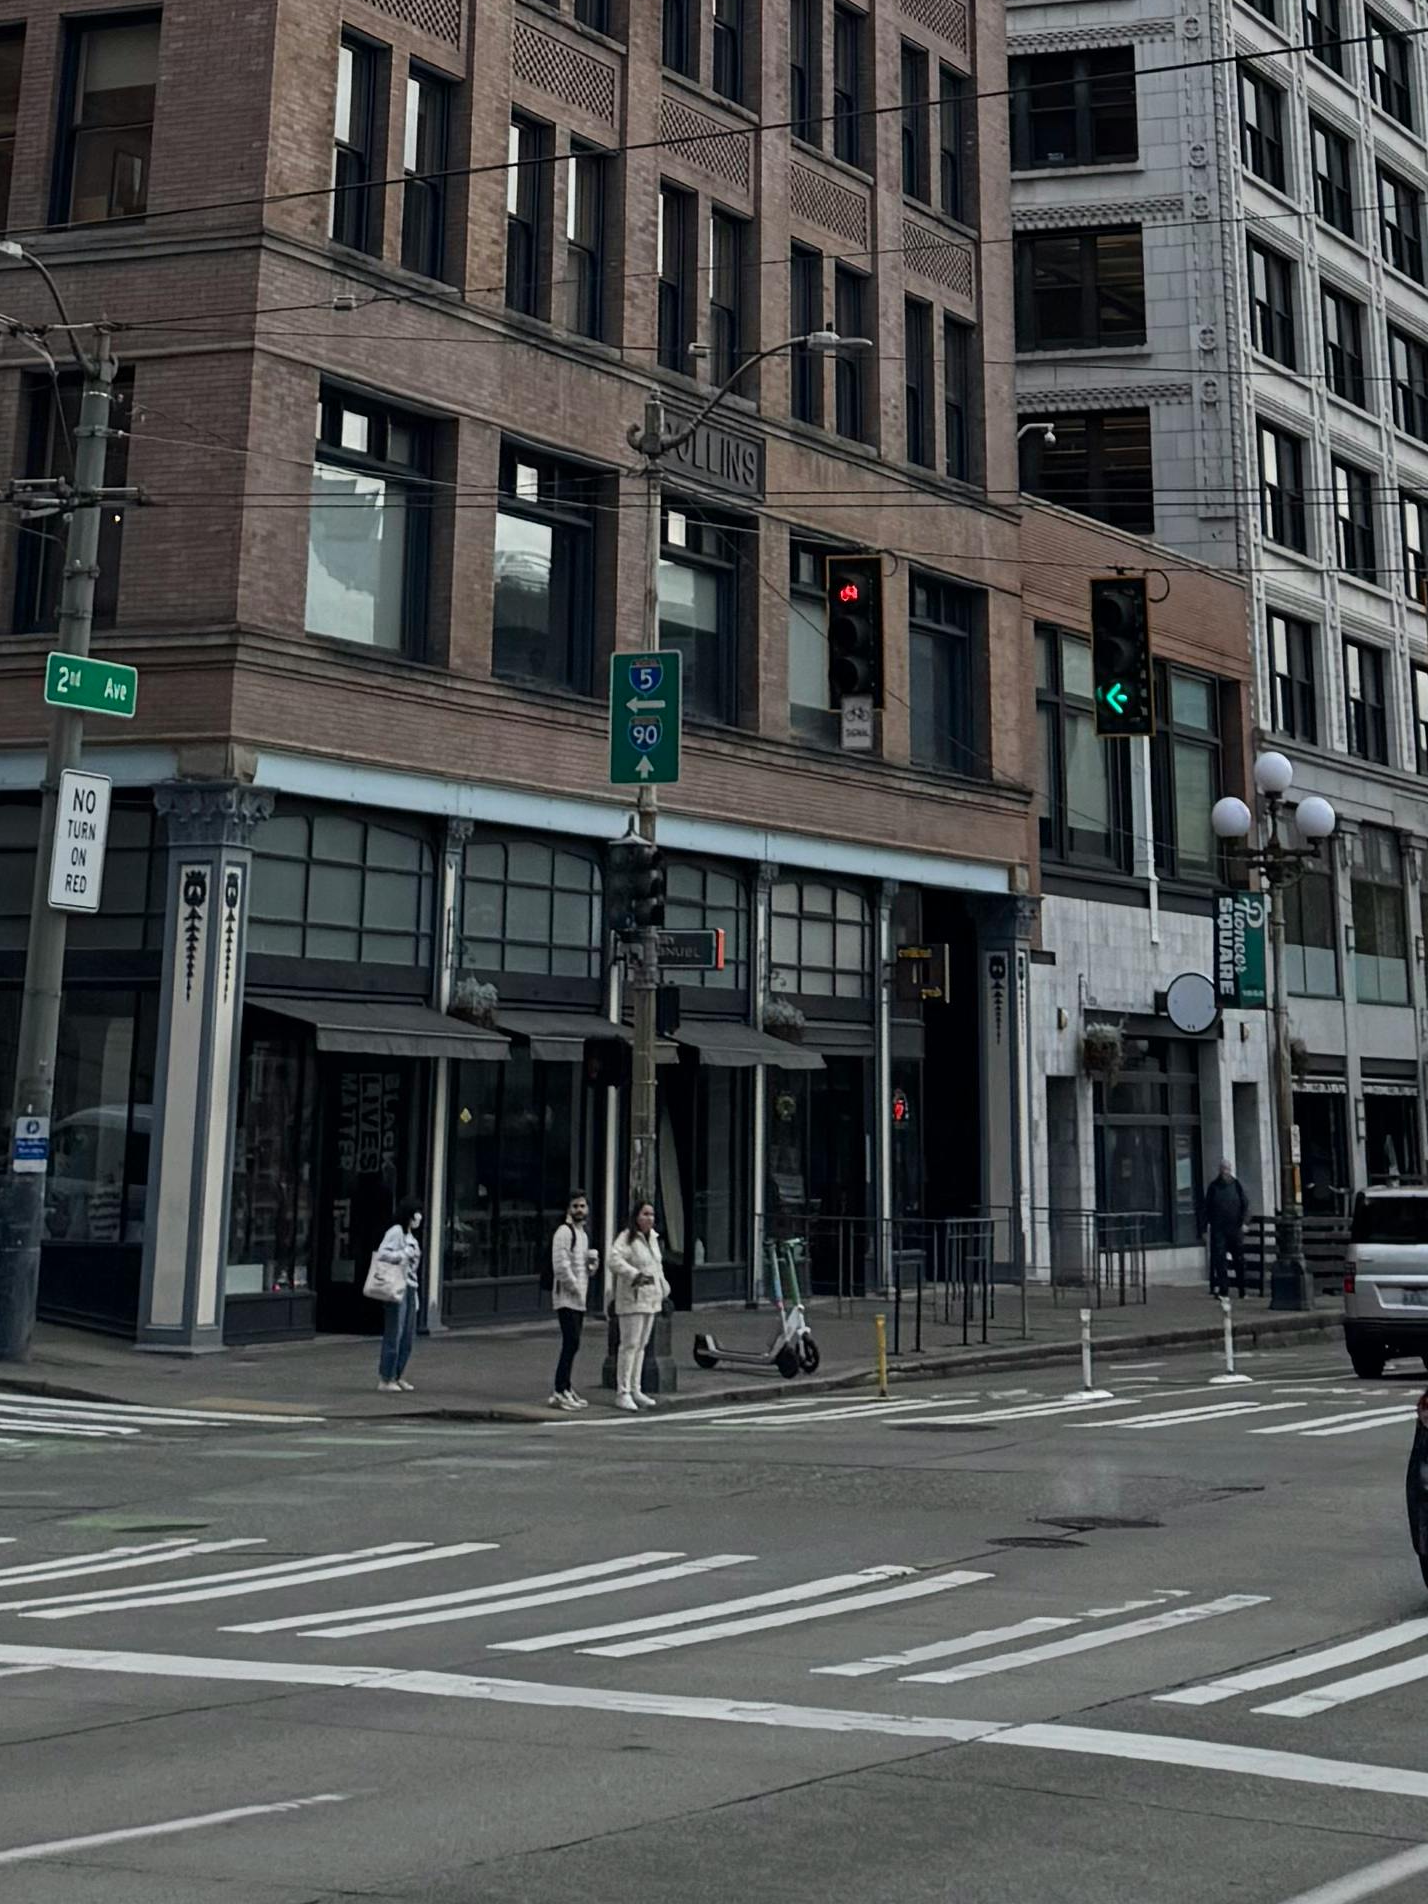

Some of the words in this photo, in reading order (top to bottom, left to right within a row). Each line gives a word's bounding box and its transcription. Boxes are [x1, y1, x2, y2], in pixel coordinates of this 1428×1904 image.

[665, 421, 756, 487] OLLINS
[57, 666, 81, 694] 2nd
[104, 678, 128, 701] Ave
[640, 668, 653, 690] 5
[633, 724, 657, 745] 90
[72, 787, 96, 814] NO
[67, 819, 97, 841] TURN
[70, 846, 87, 867] ON
[64, 873, 87, 894] RED
[1217, 897, 1235, 996] SQUARE
[1233, 896, 1264, 974] Pioneer
[360, 1075, 380, 1171] LIVES
[381, 1072, 401, 1168] BLACK
